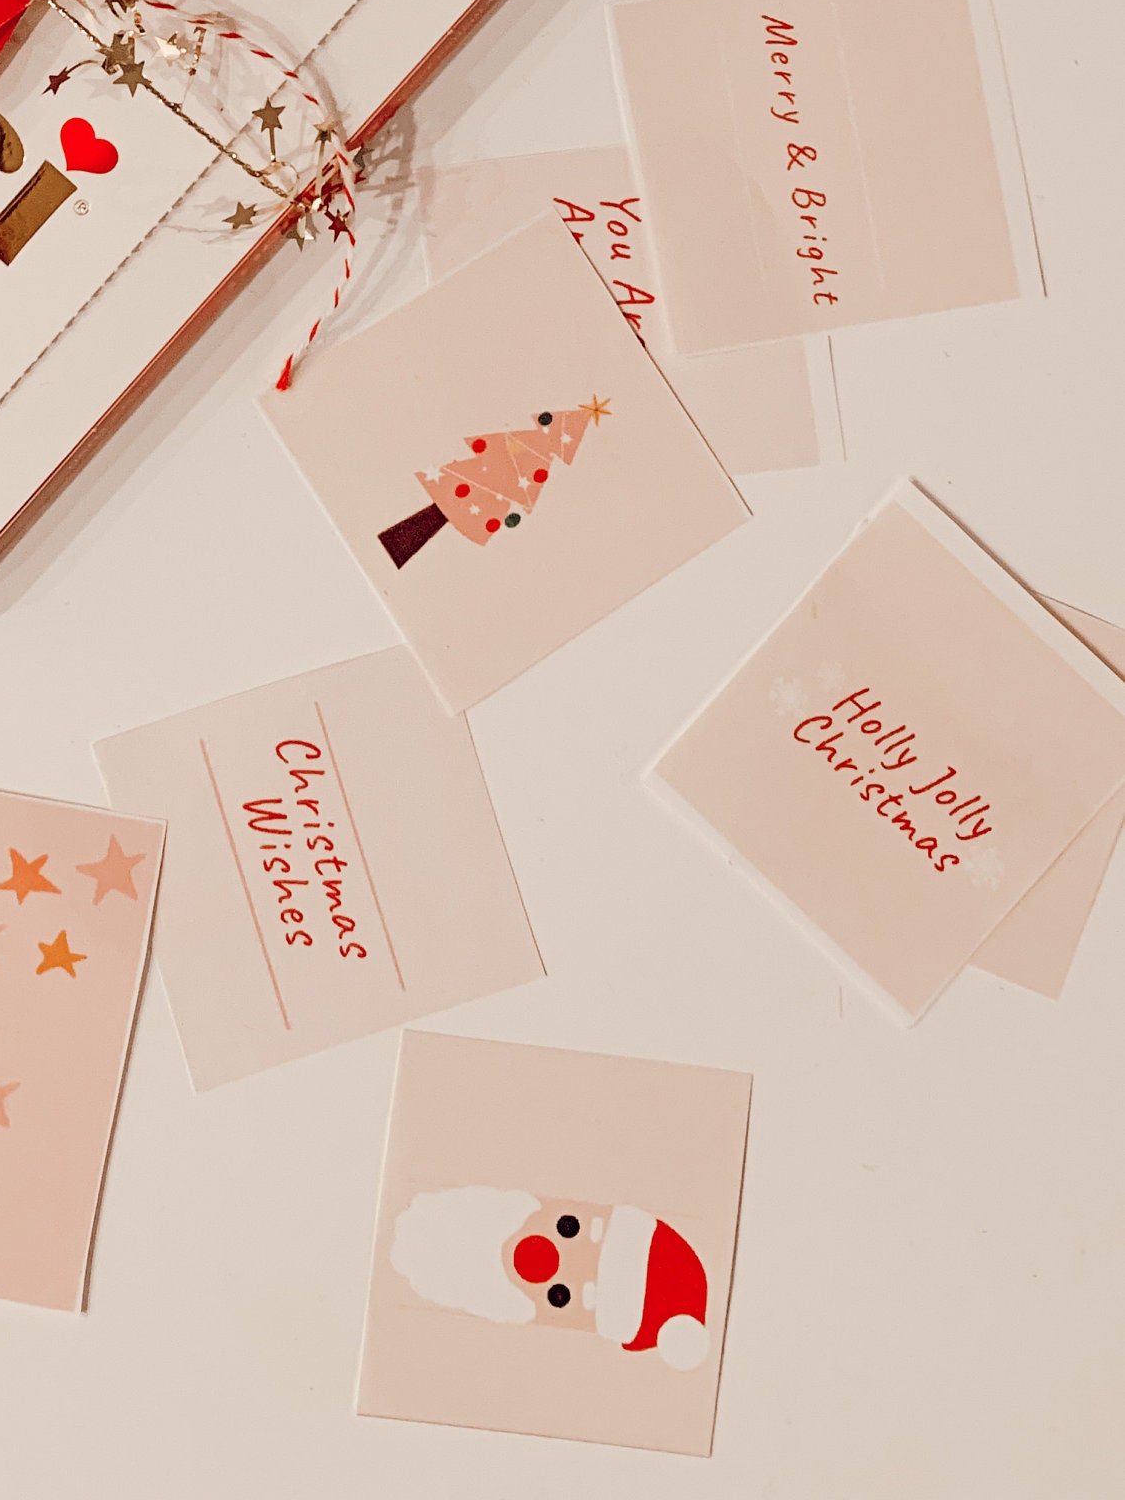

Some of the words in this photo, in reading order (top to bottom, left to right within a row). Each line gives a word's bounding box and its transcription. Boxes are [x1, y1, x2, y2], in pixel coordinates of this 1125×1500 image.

[761, 14, 800, 124] Merry
[786, 142, 817, 171] &
[599, 198, 642, 260] You
[791, 186, 839, 307] Bright
[793, 715, 959, 872] Christmas
[832, 687, 917, 770] Holly
[909, 766, 992, 841] Jolly
[243, 798, 313, 947] Wishes
[275, 739, 367, 958] Christmas
